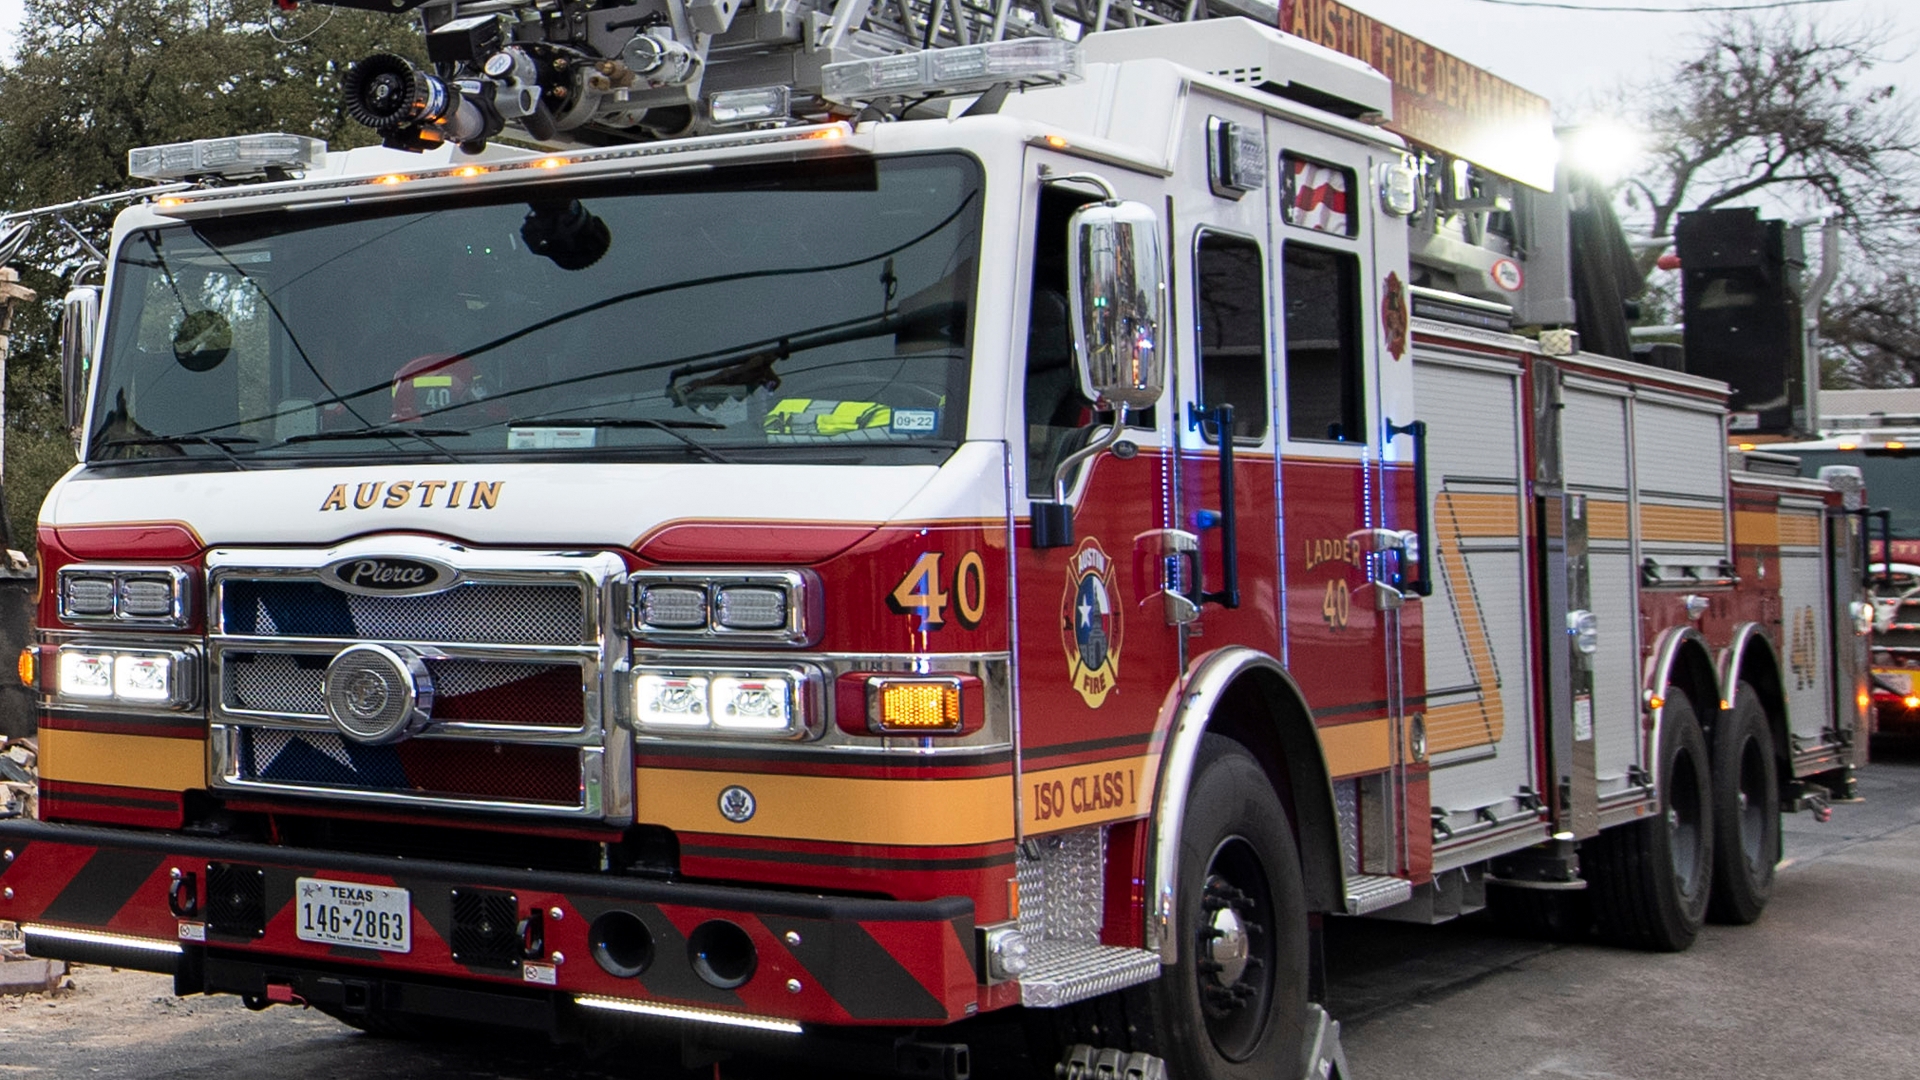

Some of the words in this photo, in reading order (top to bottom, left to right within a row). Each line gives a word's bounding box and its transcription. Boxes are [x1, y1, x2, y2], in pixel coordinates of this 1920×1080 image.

[1292, 0, 1373, 67] AUSTIN
[1381, 24, 1429, 96] FIRE
[1434, 51, 1550, 120] DEPARTME
[424, 388, 451, 409] 40
[319, 479, 506, 512] AUSTIN
[1078, 546, 1105, 575] AUSTIN
[1304, 538, 1362, 571] LADDER
[350, 559, 426, 585] Pierce
[884, 550, 987, 632] 40
[1322, 578, 1349, 633] 40
[1083, 671, 1107, 695] FIRE
[1033, 780, 1065, 821] ISO
[1070, 770, 1124, 814] CLASS
[329, 886, 374, 902] TEXAS
